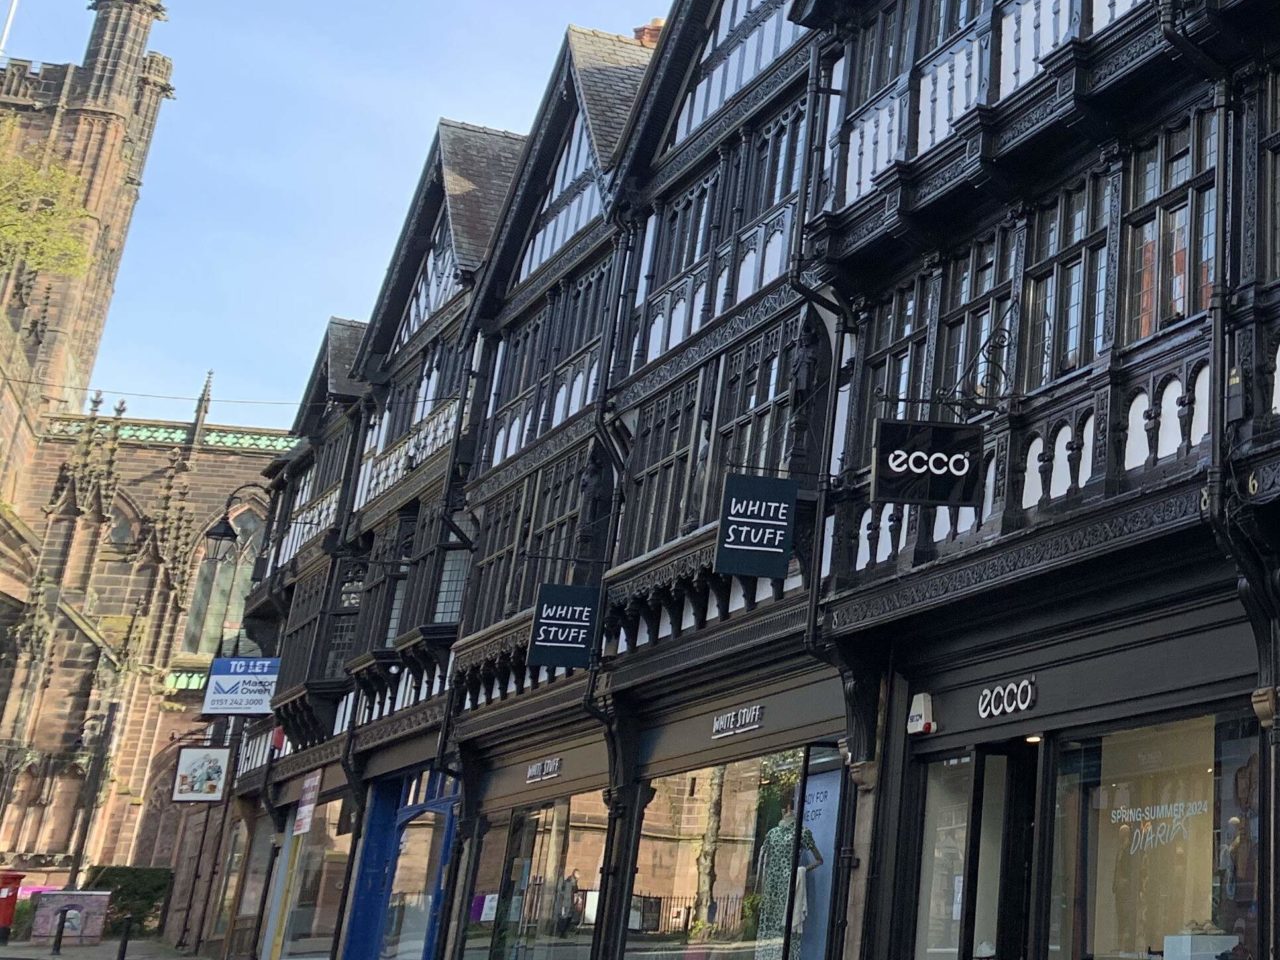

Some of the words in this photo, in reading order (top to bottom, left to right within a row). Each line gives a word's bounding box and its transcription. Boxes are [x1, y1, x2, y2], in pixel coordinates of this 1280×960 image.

[888, 449, 970, 476] ecco
[730, 497, 789, 520] WHITE
[725, 525, 785, 546] STUFF
[541, 603, 592, 621] WHITE
[536, 626, 588, 642] STUFF
[247, 660, 271, 673] LET
[240, 687, 271, 695] Owen
[978, 679, 1032, 719] ecco
[712, 711, 737, 733] WHITE
[736, 705, 761, 728] STUFF
[1111, 802, 1185, 824] SPRING-SUMMER
[1185, 800, 1208, 816] 2024
